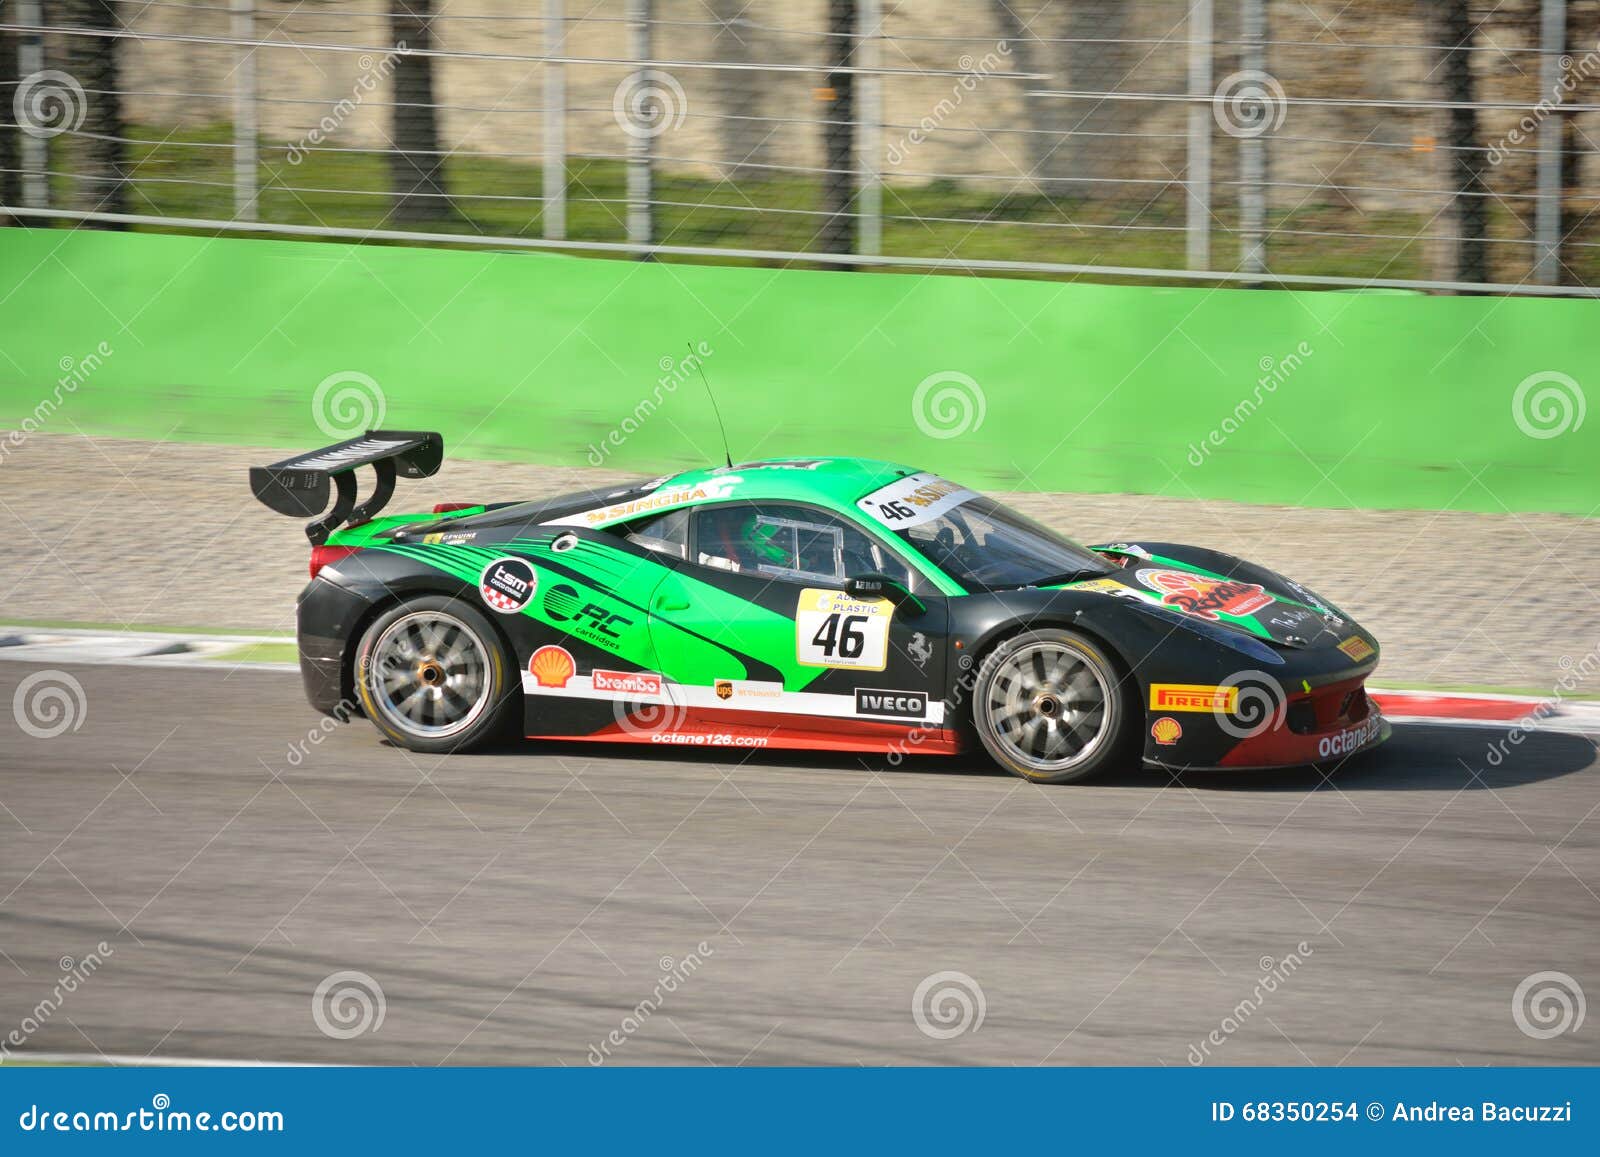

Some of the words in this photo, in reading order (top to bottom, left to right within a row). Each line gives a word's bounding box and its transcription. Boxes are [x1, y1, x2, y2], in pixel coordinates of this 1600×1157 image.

[606, 488, 707, 519] SINGHA
[878, 500, 917, 521] 46
[833, 604, 878, 614] PLASTIC
[575, 626, 621, 650] cartridges
[812, 613, 869, 659] 46
[595, 672, 658, 692] brembo
[717, 686, 733, 698] ups
[1158, 689, 1230, 708] PIRELLI
[862, 695, 922, 712] IVECO
[652, 733, 768, 747] octane126.com
